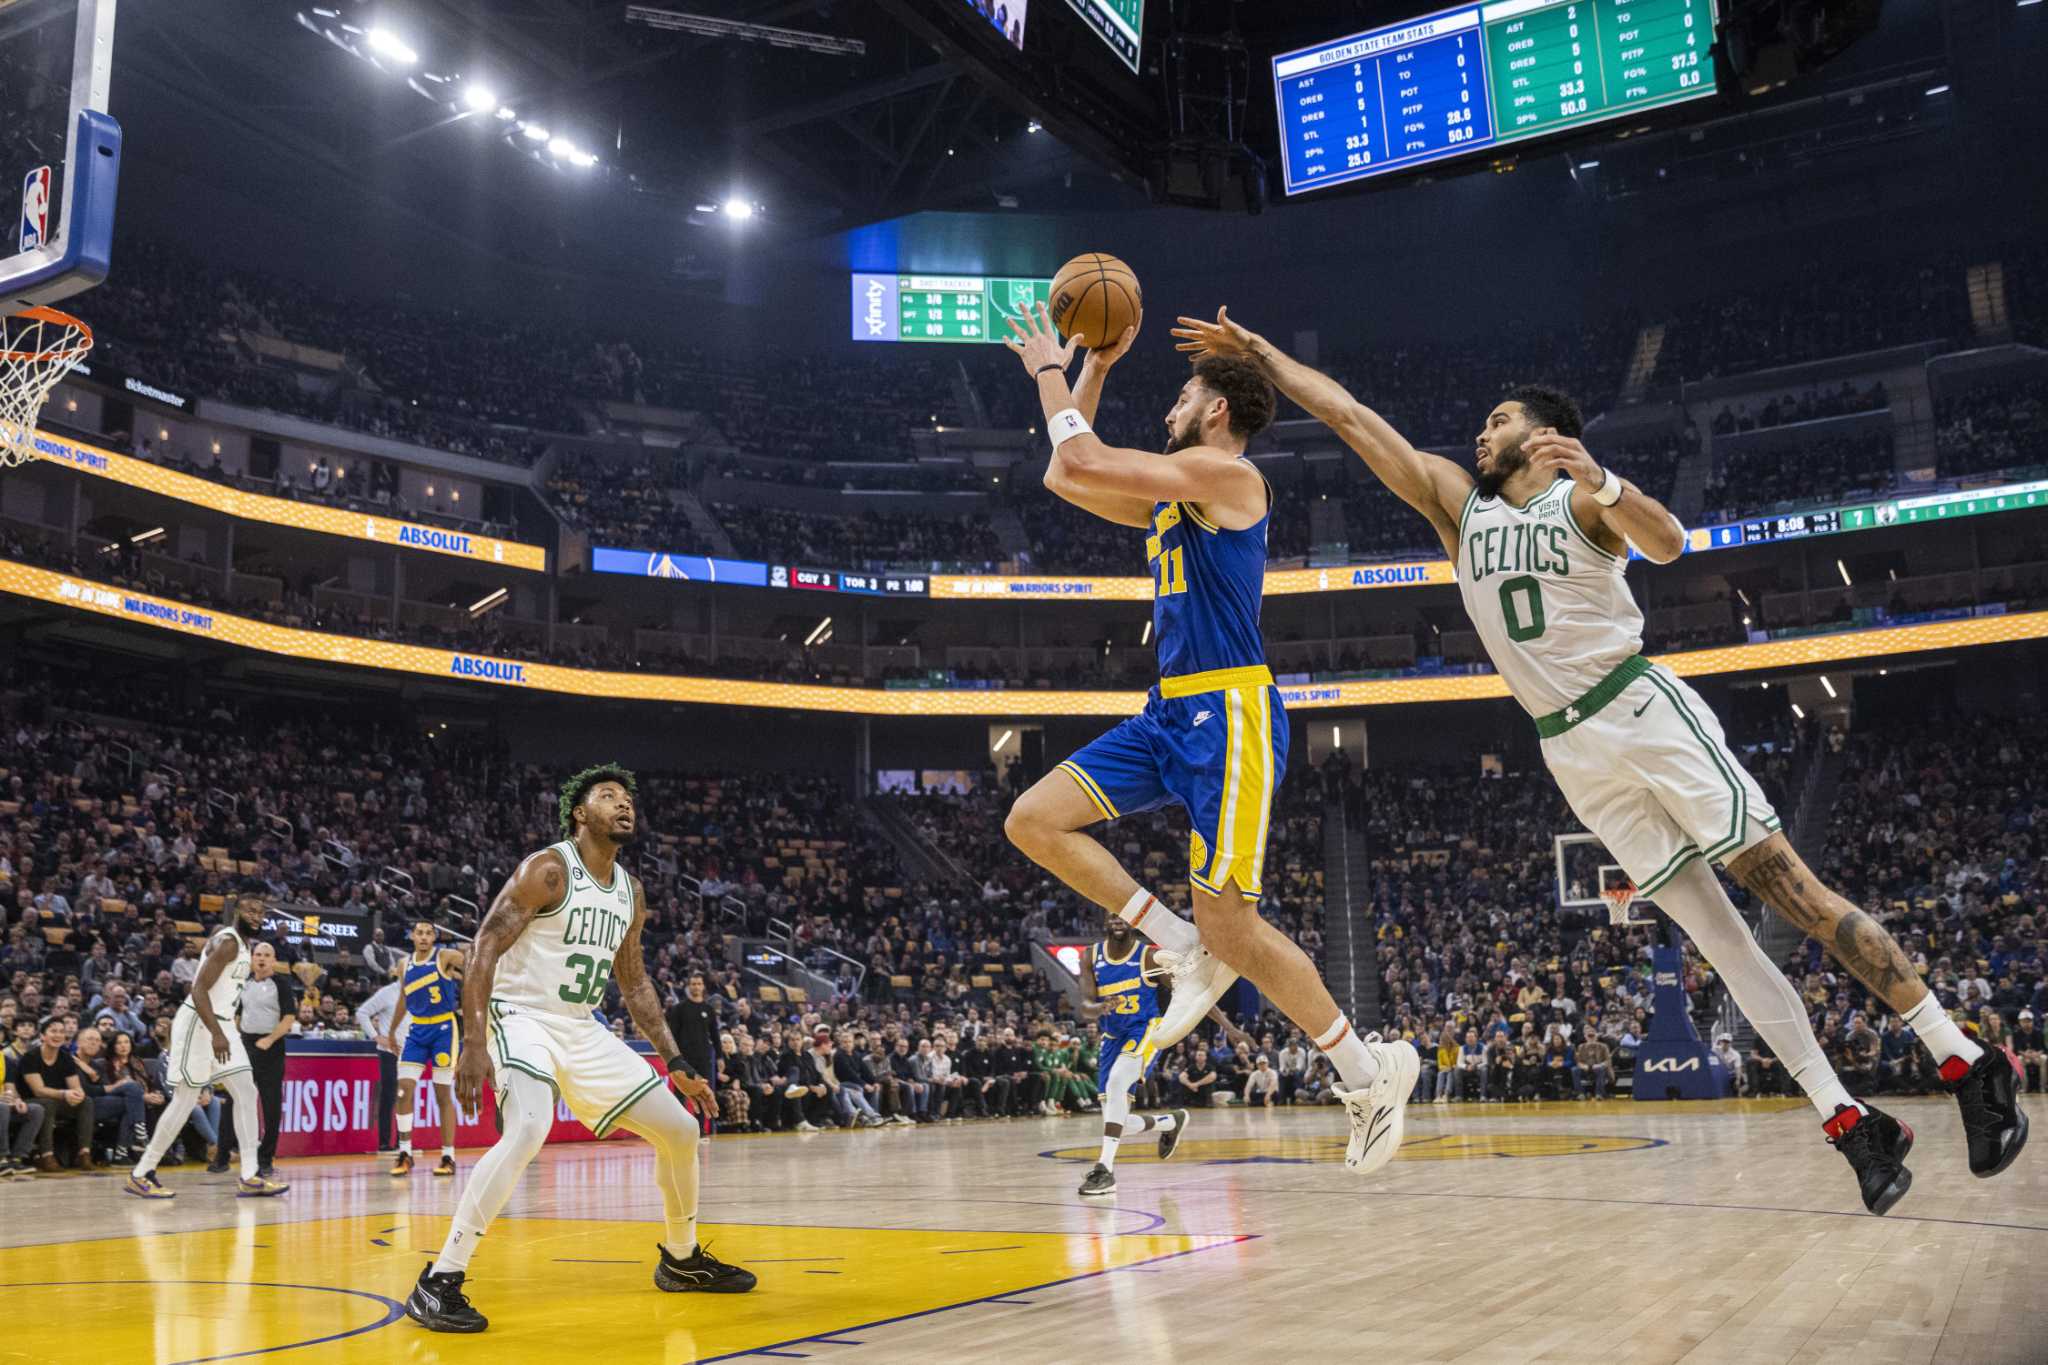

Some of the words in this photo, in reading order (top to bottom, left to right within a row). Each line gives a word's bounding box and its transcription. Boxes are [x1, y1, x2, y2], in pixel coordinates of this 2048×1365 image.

[1506, 22, 1524, 34] AST
[1567, 6, 1576, 19] 2
[1616, 13, 1631, 24] TO
[1619, 30, 1639, 42] POT
[1684, 13, 1693, 28] 0
[1319, 44, 1352, 64] GOLDEN
[1353, 39, 1380, 56] STATE
[1382, 32, 1406, 49] TEAM
[1407, 24, 1435, 42] STATS
[1396, 52, 1414, 63] BLK
[1457, 36, 1463, 48] 1
[1508, 38, 1534, 52] OREB
[1569, 24, 1578, 38] 0
[1686, 32, 1695, 46] 4
[1398, 71, 1411, 81] TO
[1457, 54, 1465, 67] 0
[1671, 51, 1698, 70] 37.5
[1298, 77, 1315, 89] AST
[1354, 63, 1362, 76] 2
[1400, 86, 1419, 98] POT
[1461, 72, 1468, 84] 1
[1512, 77, 1530, 89] STL
[1574, 61, 1582, 75] 0
[1679, 70, 1700, 88] 0.0
[1299, 94, 1323, 106] OREB
[1355, 81, 1364, 94] 0
[1461, 90, 1469, 103] 0
[1559, 79, 1585, 98] 33.3
[1301, 111, 1325, 124] DREB
[1560, 98, 1587, 116] 50.0
[1303, 131, 1319, 141] STL
[1361, 115, 1367, 128] 1
[1448, 126, 1473, 143] 50.0
[1346, 133, 1369, 150] 33.3
[1347, 151, 1371, 168] 25.0
[865, 279, 886, 336] xfinity
[1777, 516, 1805, 533] 8:08
[1853, 511, 1863, 525] 7
[399, 525, 473, 554] ABSOLUT.
[1469, 523, 1569, 582] CELTICS
[845, 577, 866, 588] TOR
[1158, 545, 1188, 597] 11
[1352, 565, 1429, 585] ABSOLUT.
[124, 597, 179, 622] WARRIORS
[181, 610, 213, 630] SPIRIT
[1499, 574, 1546, 642] 0
[451, 655, 526, 683] ABSOLUT.
[1310, 688, 1341, 700] SPIRIT
[262, 918, 303, 932] CAHE
[320, 923, 358, 937] CREEK
[563, 906, 628, 951] CELTICS
[1115, 994, 1140, 1014] 23
[279, 1079, 319, 1133] HIS
[323, 1079, 348, 1132] IS
